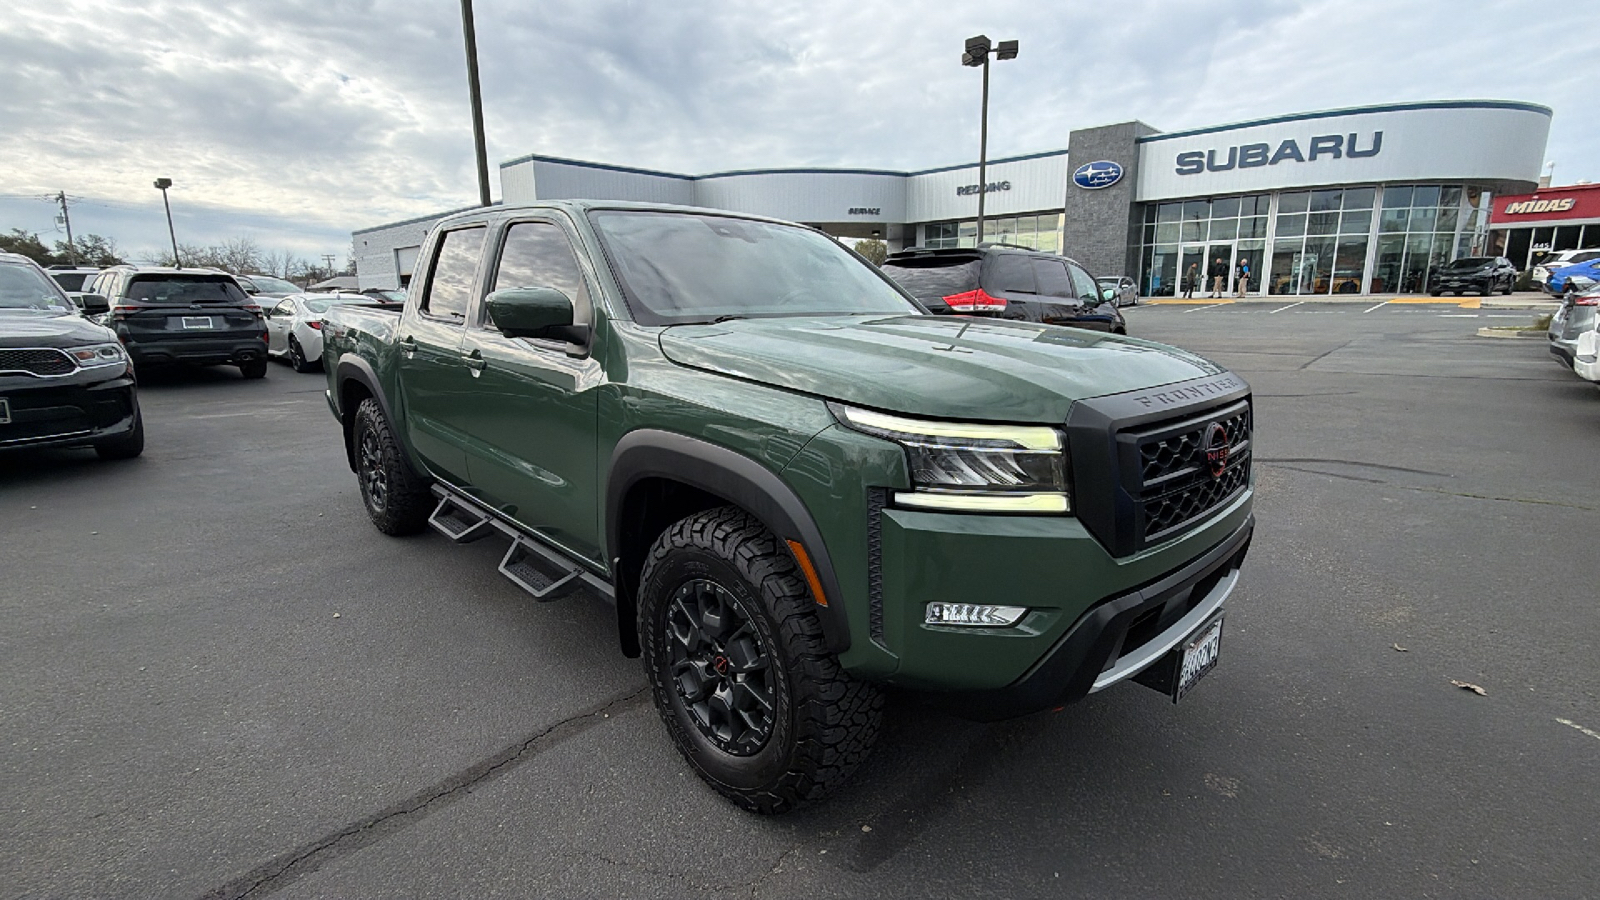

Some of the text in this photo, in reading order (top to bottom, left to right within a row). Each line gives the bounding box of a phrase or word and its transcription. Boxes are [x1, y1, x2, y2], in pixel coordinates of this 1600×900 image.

[1175, 131, 1383, 176] SUBARU
[957, 180, 1011, 196] REDDING
[848, 207, 881, 216] SERVICE
[1133, 378, 1238, 407] FRONTIER
